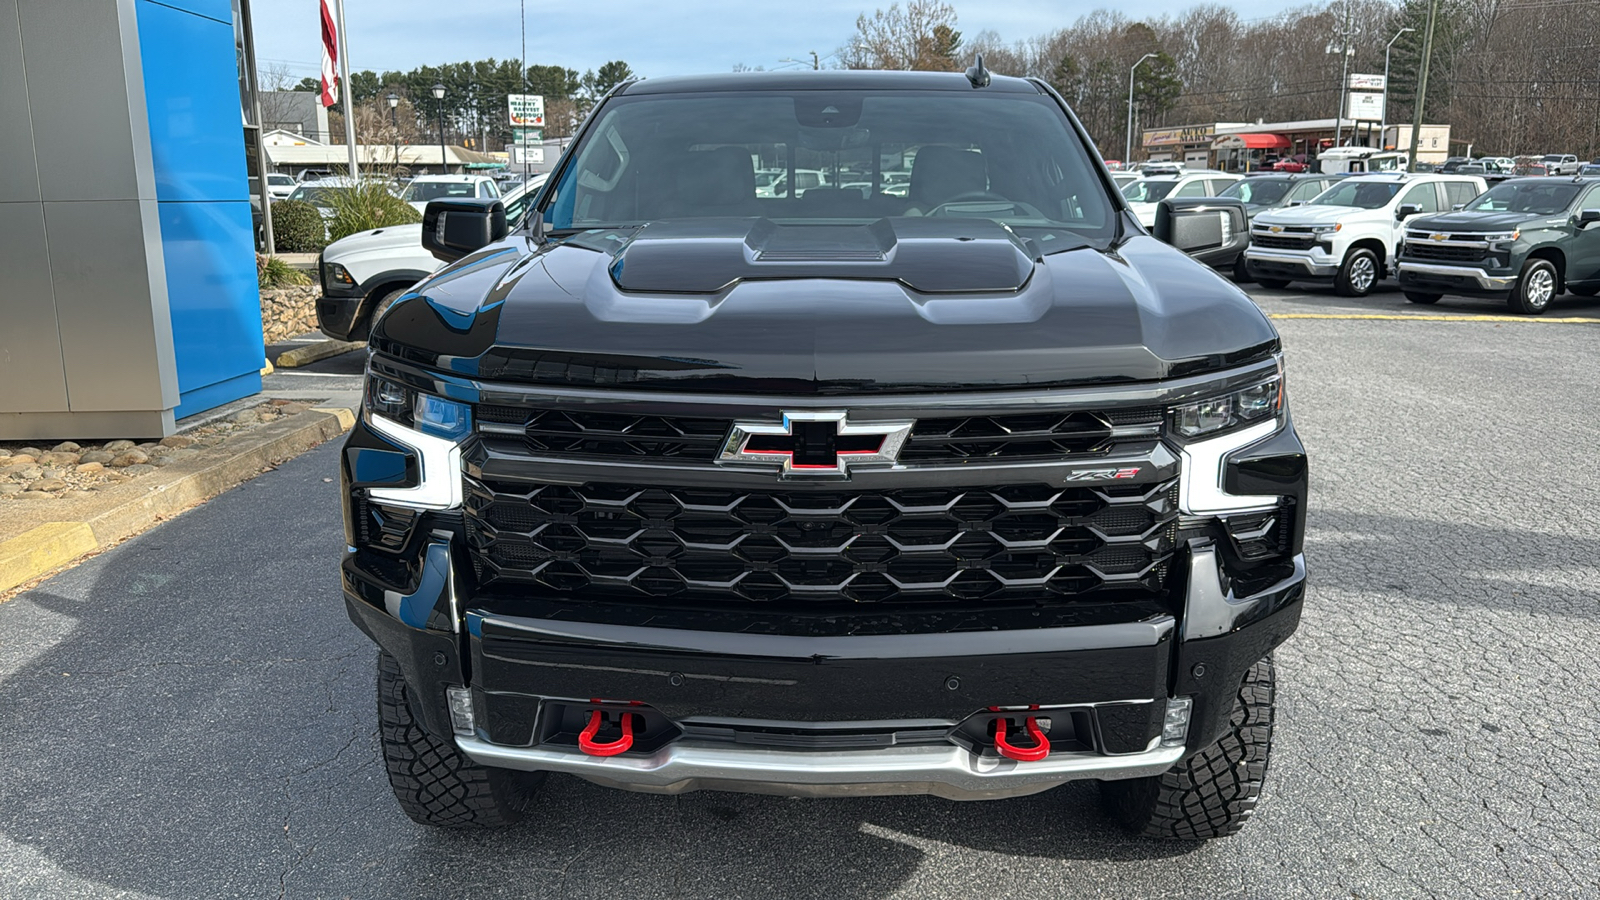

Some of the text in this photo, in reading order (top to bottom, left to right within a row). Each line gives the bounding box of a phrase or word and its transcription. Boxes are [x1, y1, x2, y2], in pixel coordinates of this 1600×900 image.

[1180, 127, 1207, 135] AUTO
[1180, 134, 1206, 142] MART
[1066, 466, 1142, 482] ZR2
